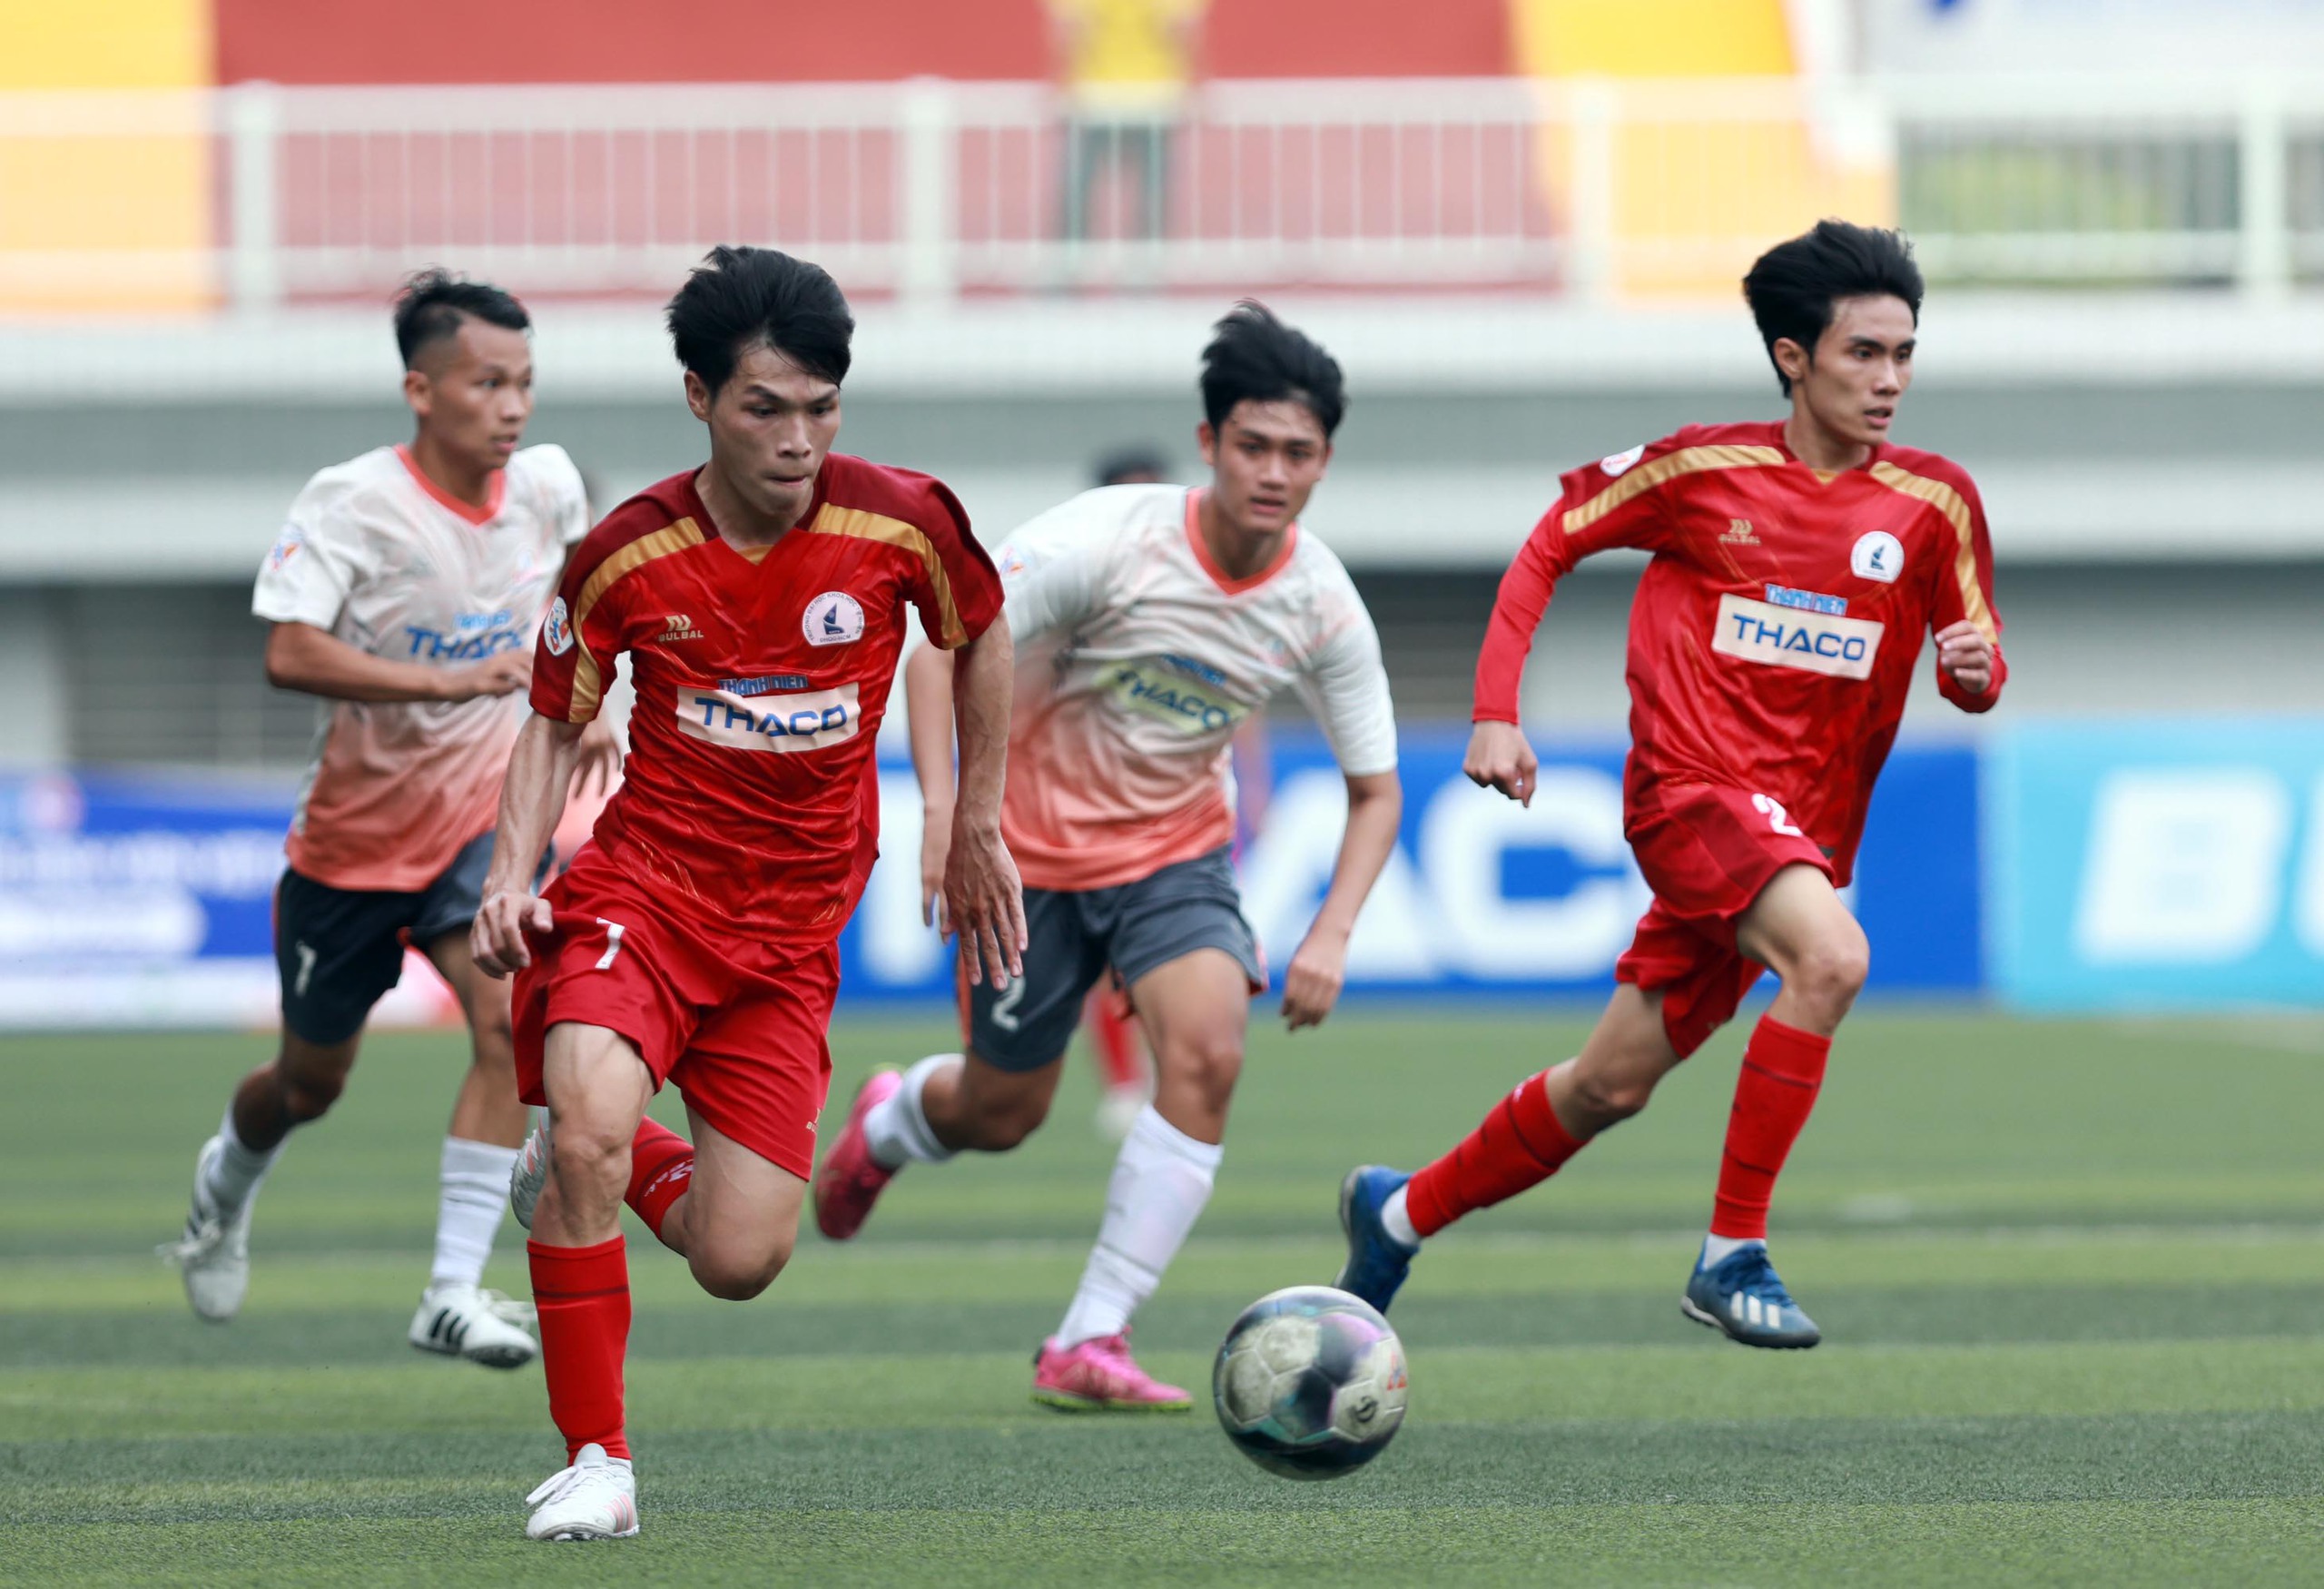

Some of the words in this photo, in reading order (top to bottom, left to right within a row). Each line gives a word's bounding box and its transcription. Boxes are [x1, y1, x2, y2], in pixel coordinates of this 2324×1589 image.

[1732, 611, 1866, 662] THACO
[694, 696, 848, 737] THACO
[595, 916, 625, 970] 7
[988, 967, 1026, 1031] 2
